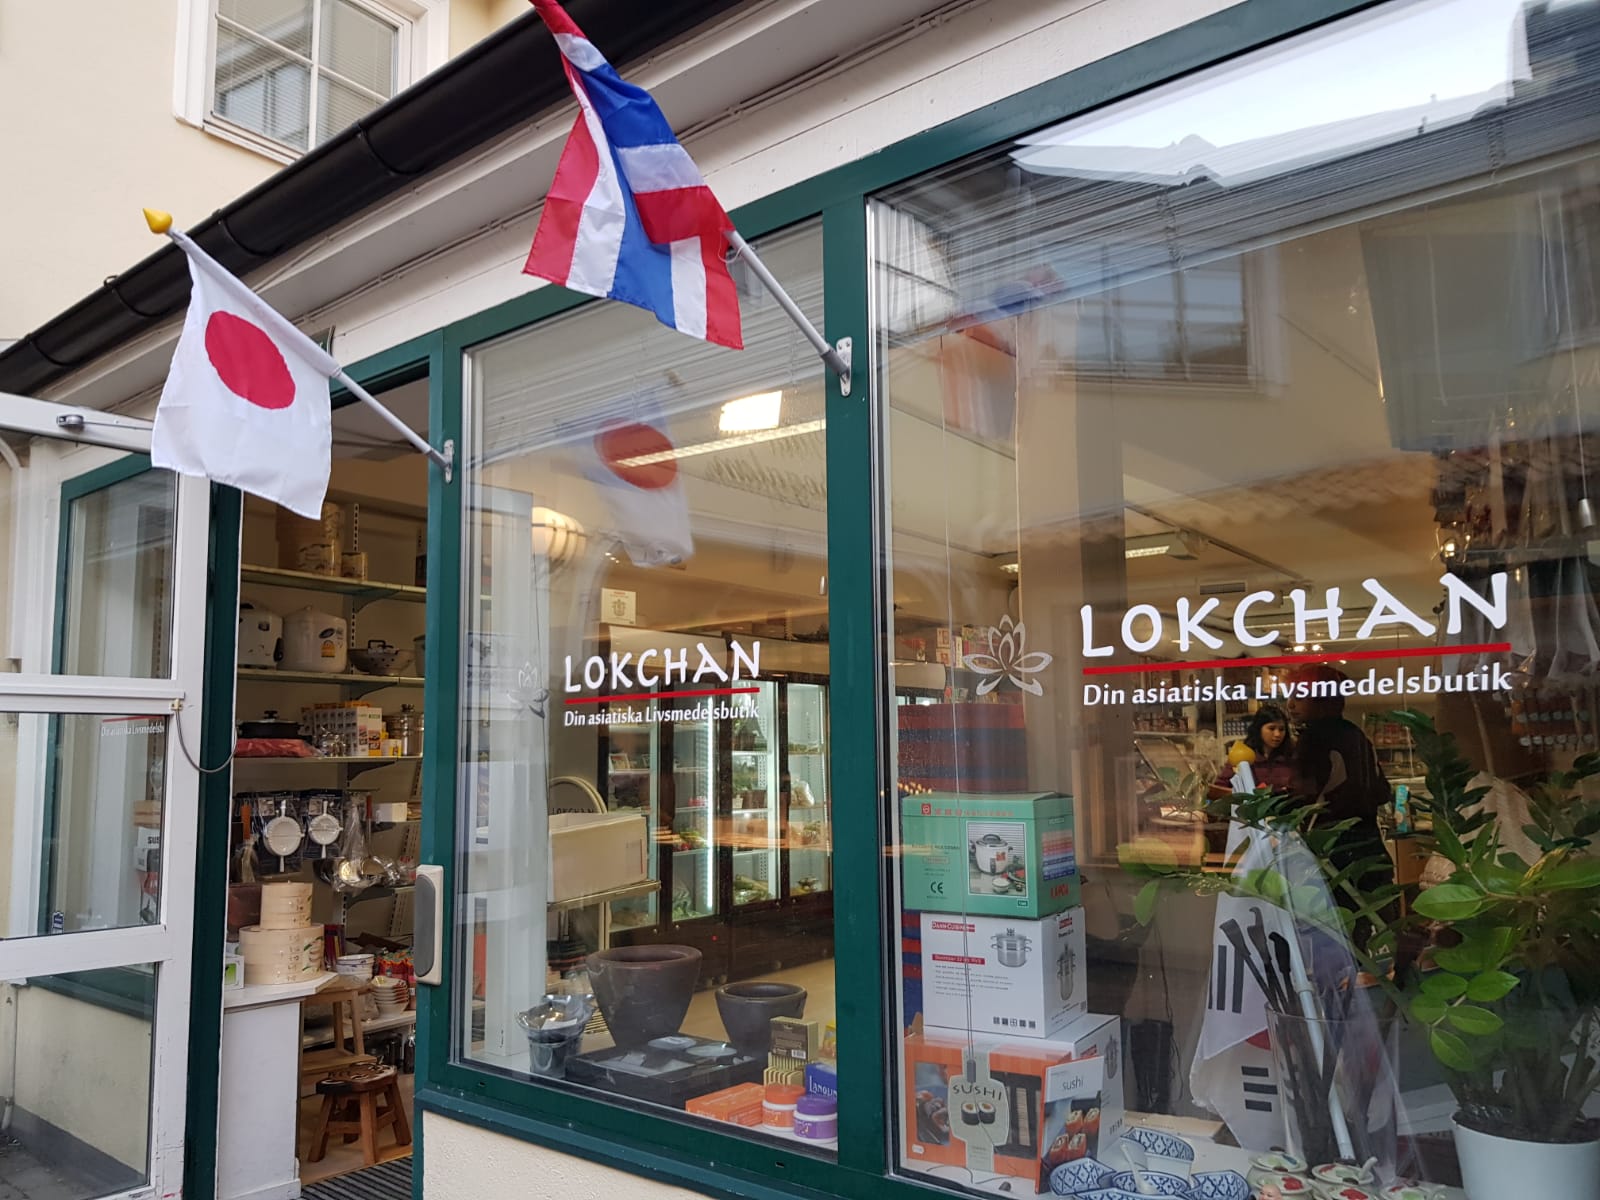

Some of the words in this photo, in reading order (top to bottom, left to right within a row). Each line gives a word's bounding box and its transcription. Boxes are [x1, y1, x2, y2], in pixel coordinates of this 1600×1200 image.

[1080, 572, 1508, 657] LOKCHAN
[564, 640, 761, 693] LOKCHAN
[1083, 684, 1125, 706] Din
[1131, 674, 1247, 704] asiatiska
[1255, 662, 1513, 701] Livsmedelsbutik
[564, 710, 586, 727] Din
[588, 706, 643, 725] asiatiska
[953, 1083, 1002, 1101] SUSHI
[1062, 1075, 1084, 1092] sushi
